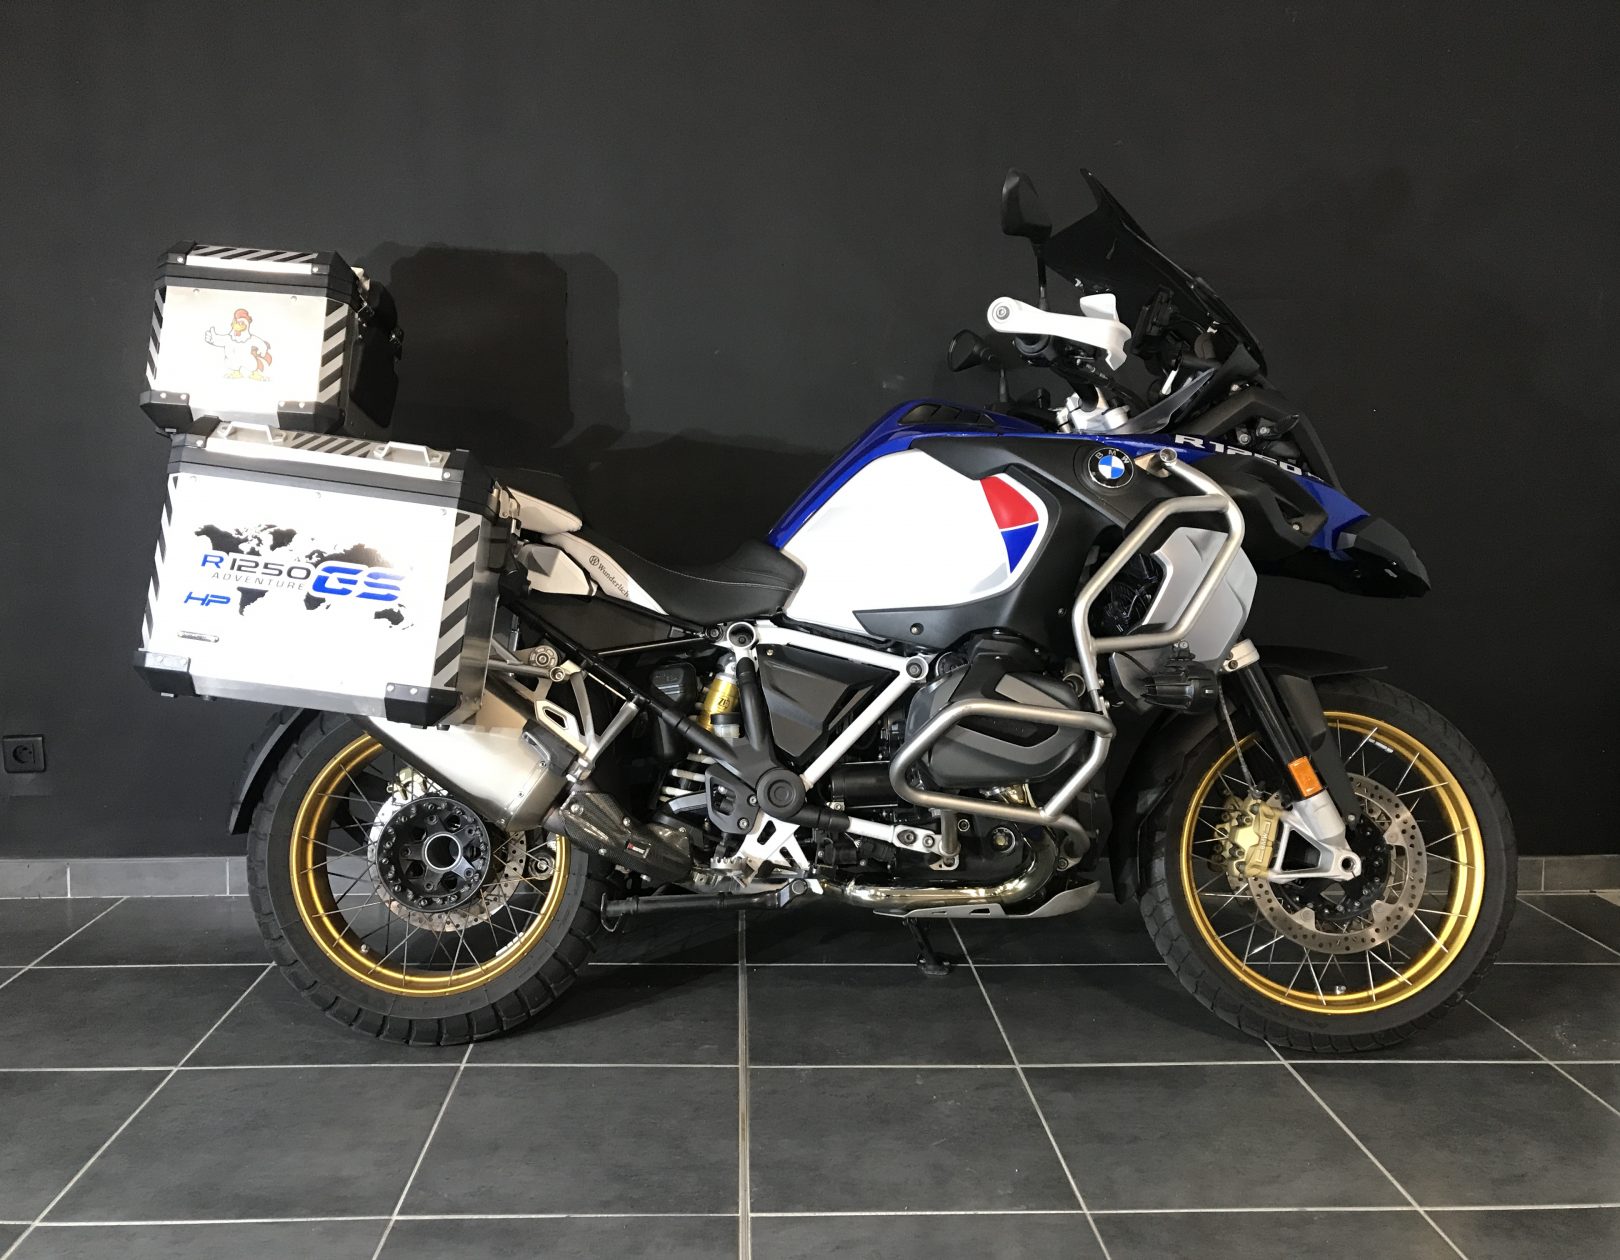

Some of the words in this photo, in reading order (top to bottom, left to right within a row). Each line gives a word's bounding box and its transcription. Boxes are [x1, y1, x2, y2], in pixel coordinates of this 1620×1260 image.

[1095, 449, 1130, 464] BMW
[211, 571, 305, 591] ADVENTURE
[312, 565, 406, 602] GS
[598, 562, 630, 598] Wunderlich
[183, 591, 231, 607] HP
